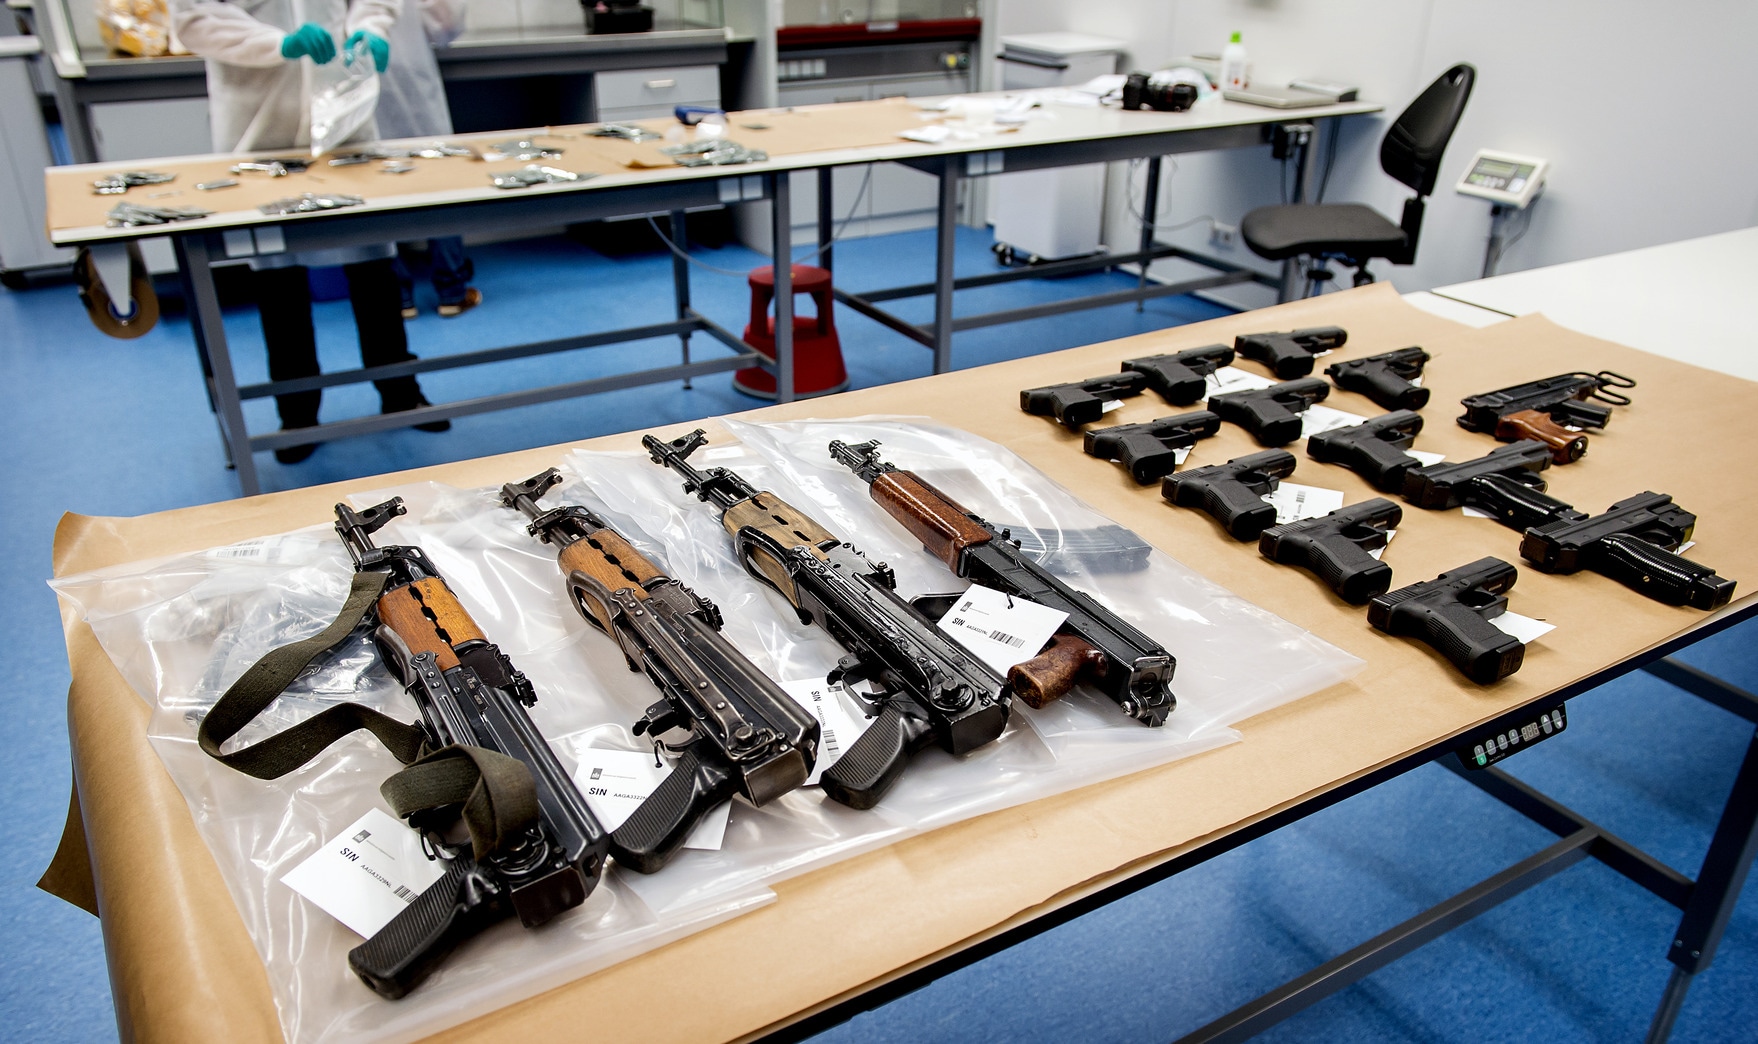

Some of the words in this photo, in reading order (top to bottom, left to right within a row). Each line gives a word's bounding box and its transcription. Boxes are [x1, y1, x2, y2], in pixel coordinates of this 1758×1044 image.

[952, 617, 966, 626] SIN
[811, 691, 822, 702] SIN
[588, 787, 608, 796] SIN
[340, 847, 360, 862] SIN
